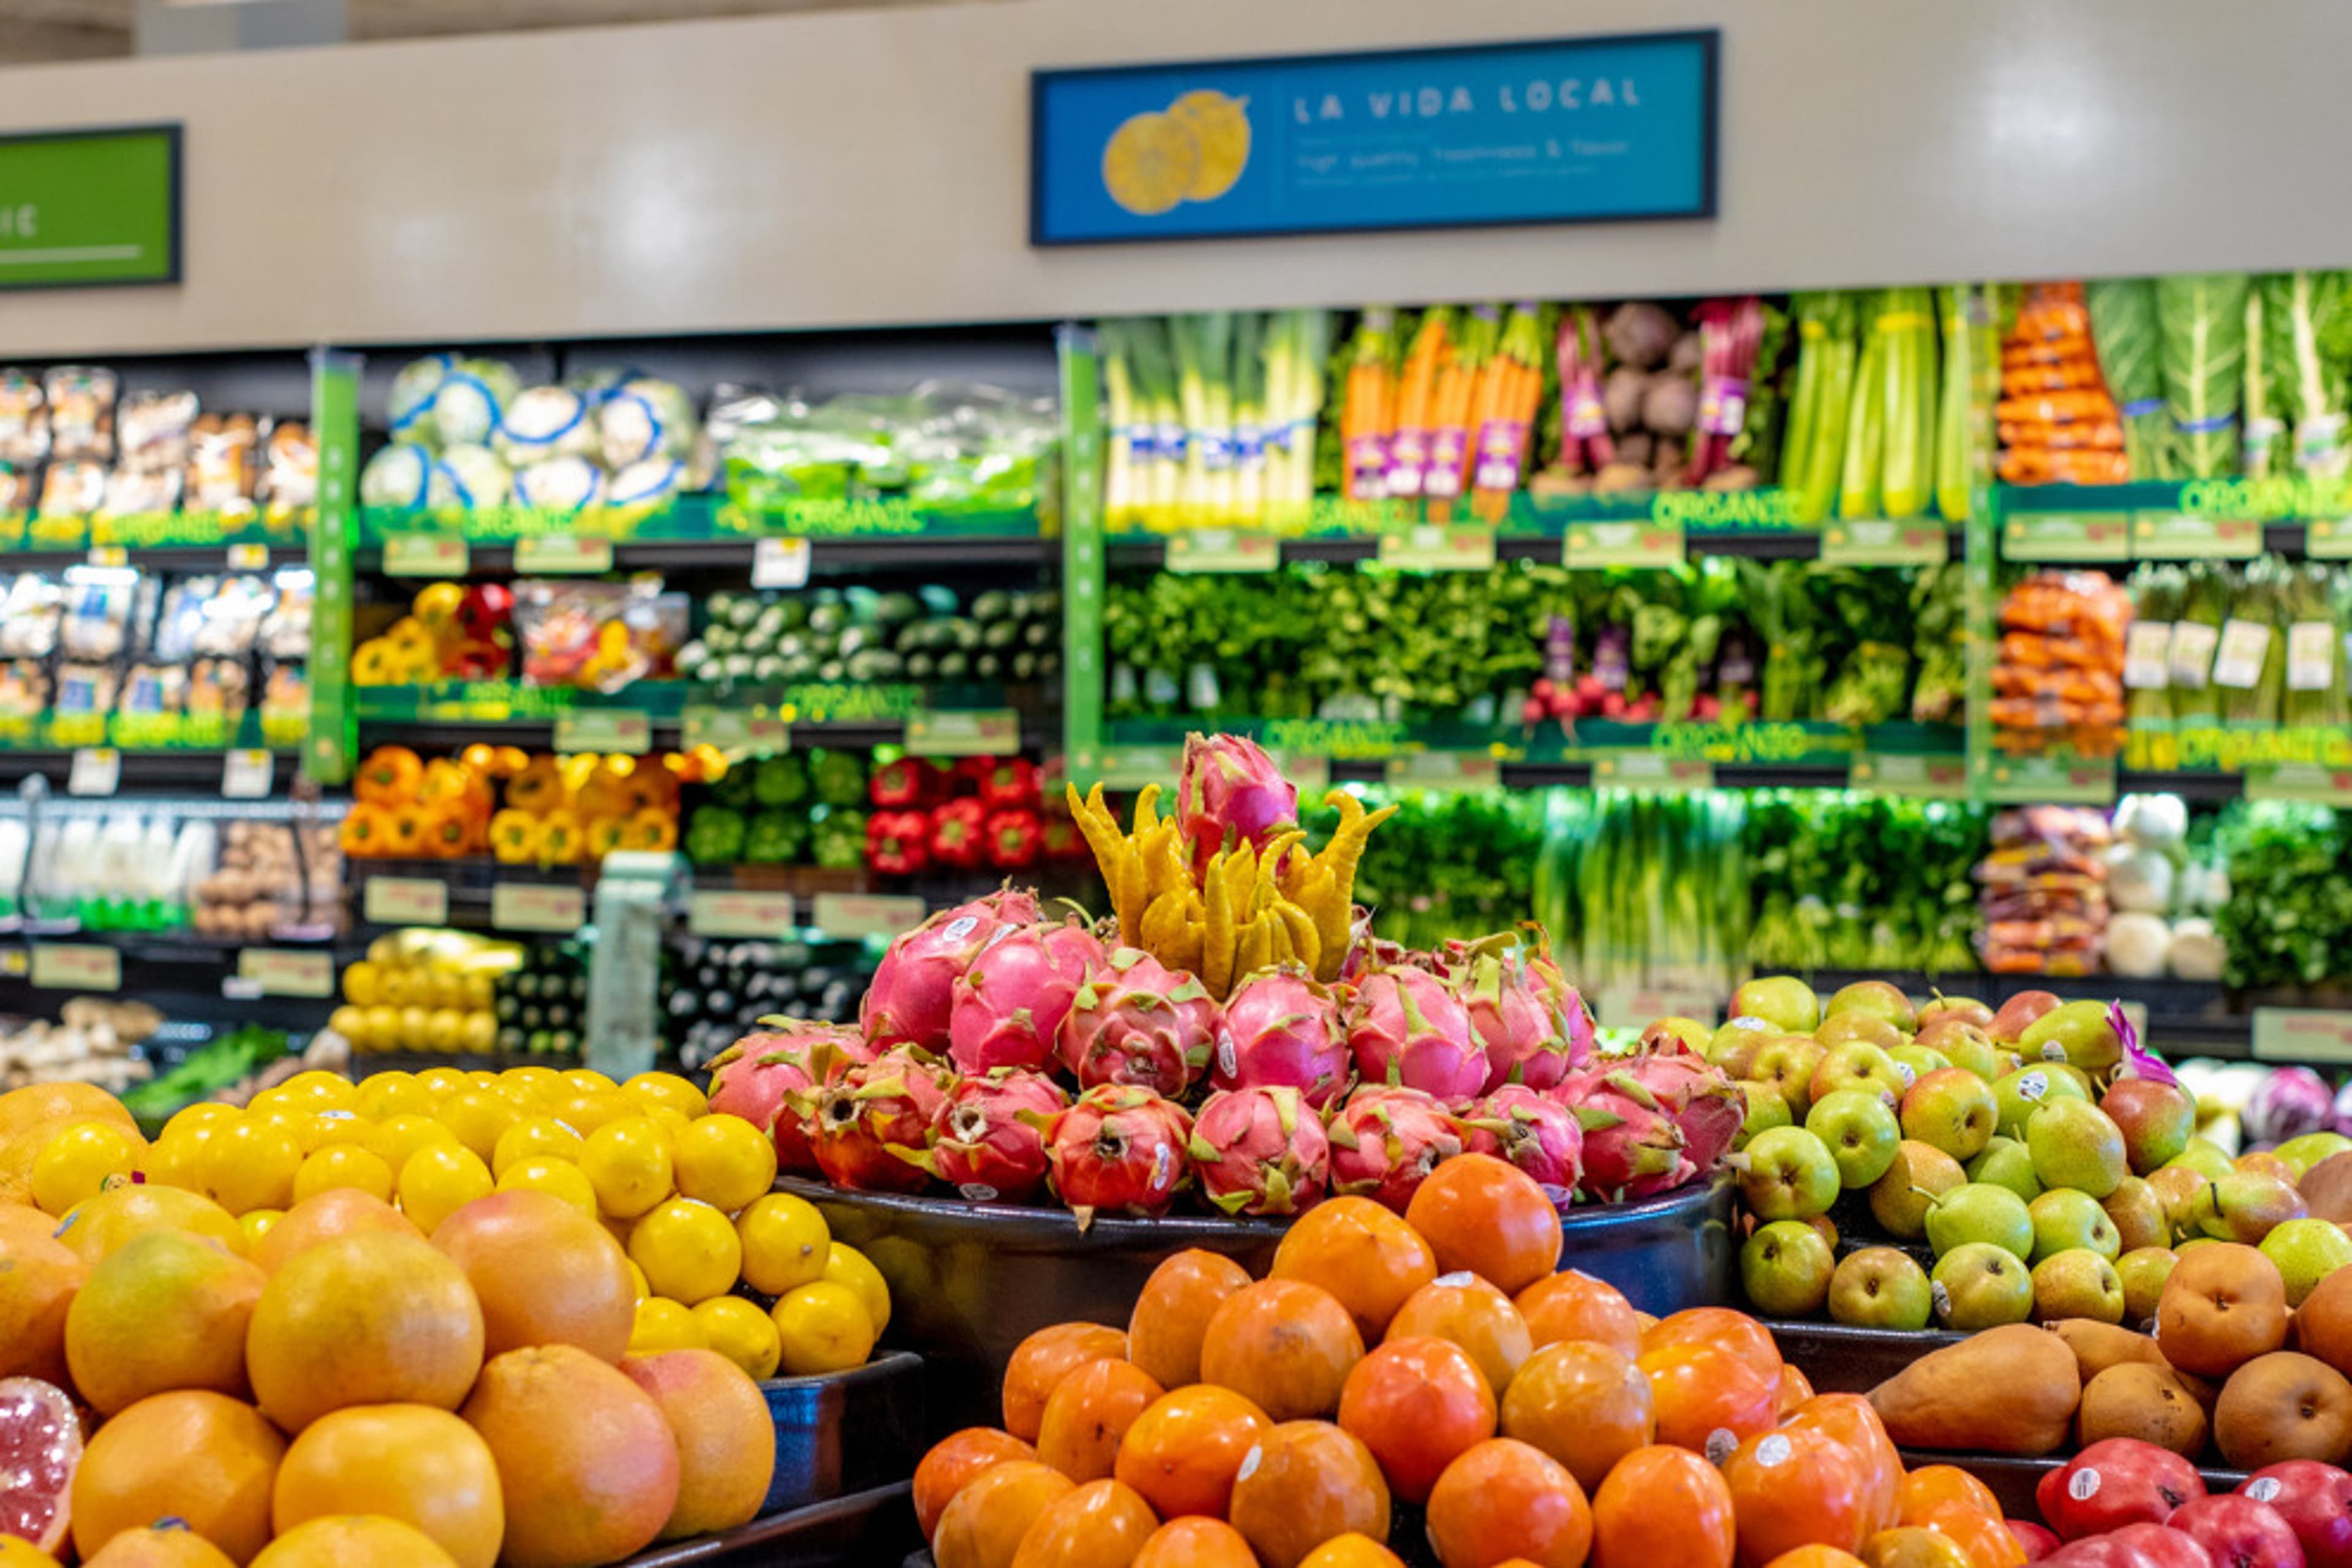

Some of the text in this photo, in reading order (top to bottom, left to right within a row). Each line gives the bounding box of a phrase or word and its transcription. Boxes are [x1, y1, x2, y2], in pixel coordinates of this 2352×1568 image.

[1294, 77, 1641, 124] LA VIDA LOCAL
[785, 497, 927, 534] ORGANIC
[1653, 491, 1807, 529] ORGANIC
[1651, 723, 1807, 762] ORGANIC
